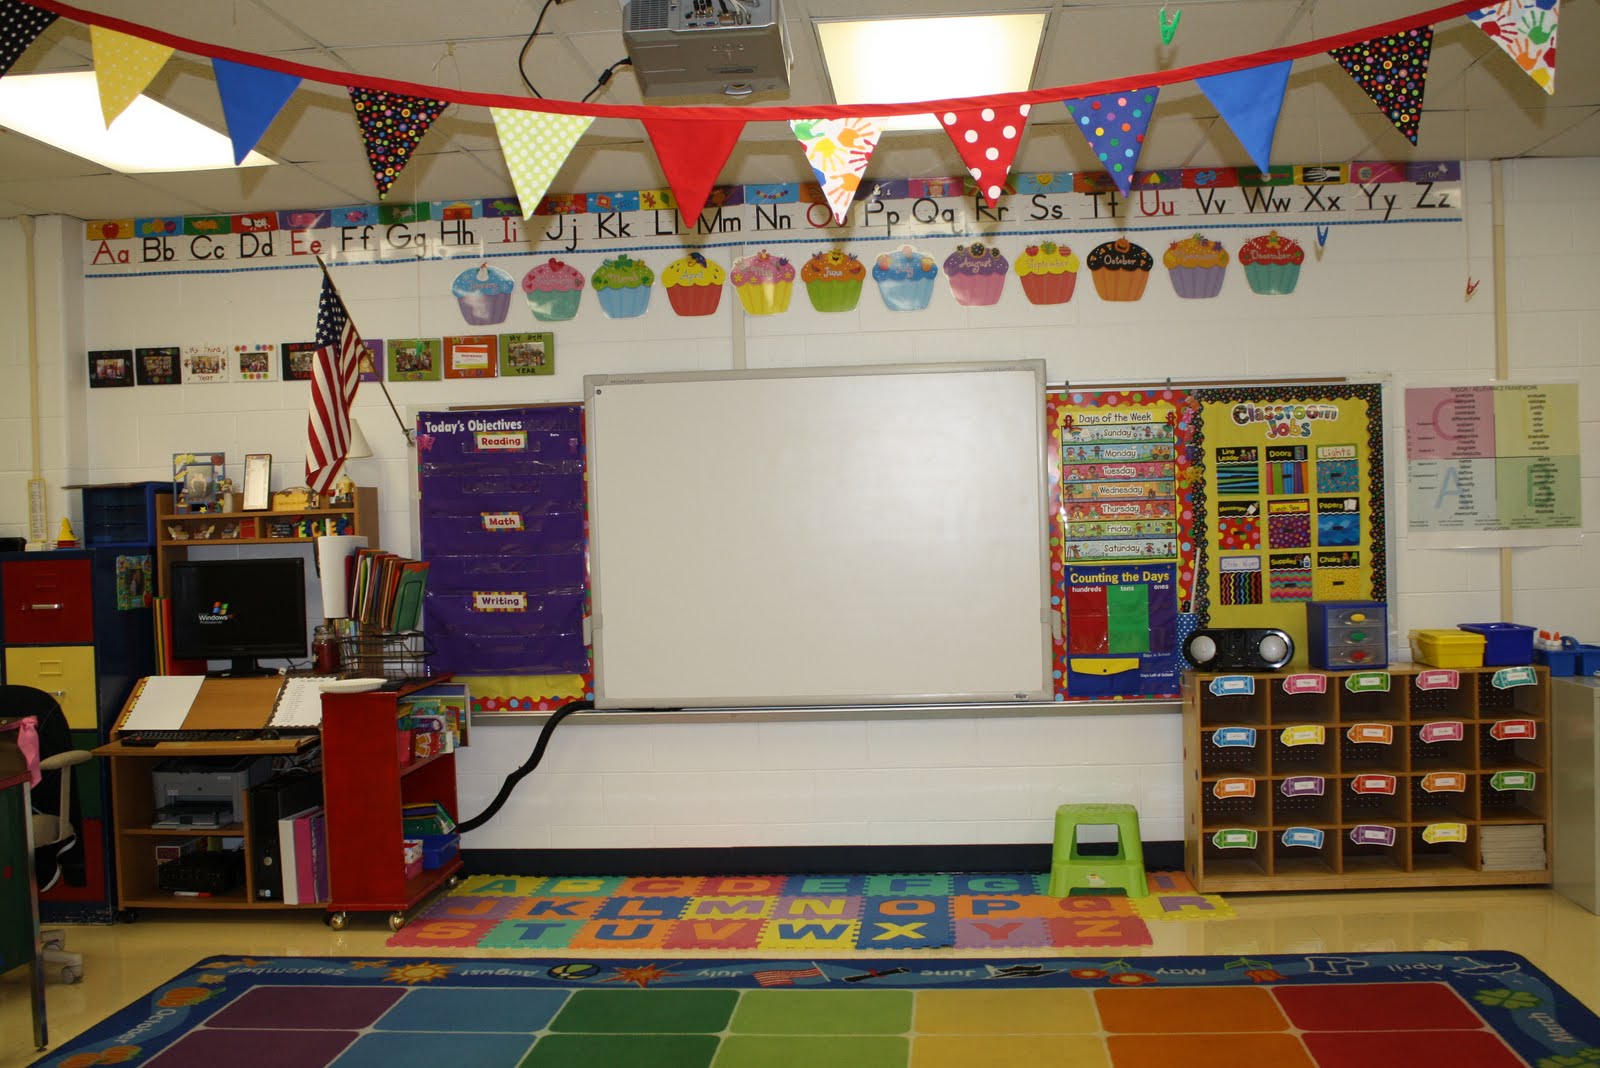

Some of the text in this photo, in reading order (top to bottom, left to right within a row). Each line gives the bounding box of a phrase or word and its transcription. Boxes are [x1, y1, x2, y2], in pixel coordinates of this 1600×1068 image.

[92, 240, 129, 265] Aa
[143, 236, 175, 263] Bb
[190, 235, 225, 260] Cc
[240, 232, 273, 258] Dd
[291, 230, 322, 254] Ee
[341, 225, 374, 251] Ff
[386, 224, 426, 260] Gg
[441, 219, 474, 245] Hh
[502, 217, 517, 243] Ii
[546, 214, 577, 251] Jj
[598, 212, 631, 238] Kk
[655, 209, 679, 235] Ll
[698, 207, 742, 234] Mm
[756, 203, 791, 230] Nn
[864, 200, 900, 236] Pp
[912, 197, 963, 234] Qq
[975, 196, 1009, 222] Rr
[1031, 194, 1063, 220] Ss
[1085, 191, 1119, 218] Tt
[1140, 190, 1174, 216] Uu
[1195, 188, 1226, 214] Vv
[1242, 187, 1291, 213] Ww
[1303, 185, 1341, 211] Xx
[1359, 183, 1396, 220] Yy
[1415, 182, 1451, 208] Zz
[680, 270, 704, 283] April
[824, 267, 843, 278] June
[959, 257, 992, 273] August
[1026, 258, 1069, 272] September
[1104, 254, 1136, 266] October
[1250, 249, 1292, 260] December
[516, 367, 536, 375] YEAR
[1079, 412, 1152, 424] Days of the Week
[1231, 403, 1338, 425] Classroom
[425, 418, 522, 434] Today's Objectives
[1103, 429, 1132, 438] Sunday
[481, 437, 521, 446] Reading
[1104, 449, 1137, 459] Monday
[1321, 448, 1352, 459] Lights
[1103, 466, 1136, 476] Tuesday
[1099, 485, 1143, 496] Wednesday
[1102, 504, 1140, 514] Thursday
[489, 517, 516, 526] Math
[1106, 524, 1132, 534] Friday
[1104, 544, 1141, 554] Saturday
[1271, 558, 1297, 566] Supplies
[1319, 556, 1341, 564] Chairs
[1070, 571, 1170, 585] Counting the Days
[481, 596, 520, 606] Writing
[470, 879, 517, 893] A
[549, 879, 605, 893] B
[631, 880, 684, 893] C
[717, 879, 771, 893] D
[800, 879, 850, 893] E
[889, 878, 933, 892] F
[967, 878, 1020, 892] G
[527, 901, 586, 915] K
[616, 901, 663, 916] L
[696, 900, 766, 914] M
[788, 899, 848, 915] N
[972, 899, 1021, 915] P
[416, 920, 1122, 941] S T U V W X Y Z
[227, 965, 348, 976] September
[460, 967, 541, 978] August
[696, 967, 743, 979] July
[1155, 966, 1207, 977] May
[1385, 961, 1444, 974] April
[920, 968, 976, 979] June
[113, 1008, 177, 1044] October
